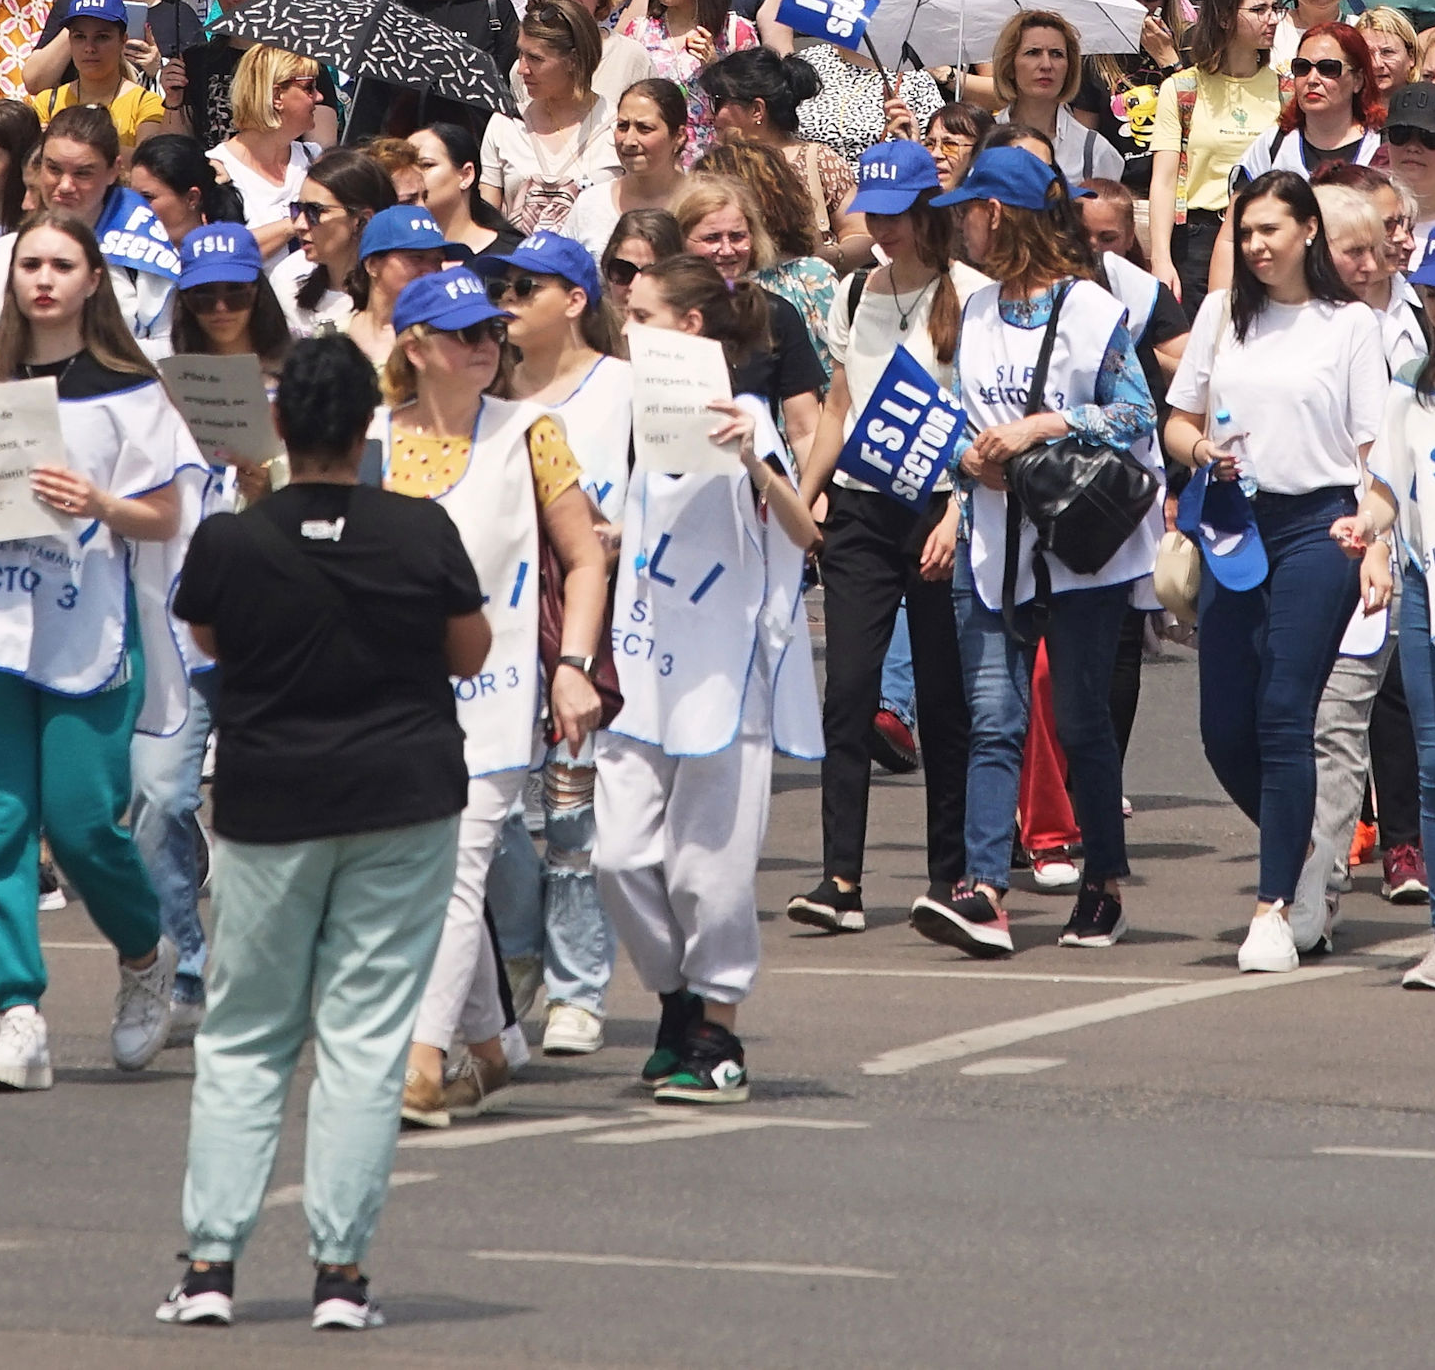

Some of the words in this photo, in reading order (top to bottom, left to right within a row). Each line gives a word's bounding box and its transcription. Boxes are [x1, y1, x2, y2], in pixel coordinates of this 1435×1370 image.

[862, 162, 898, 181] FSLI
[192, 234, 236, 259] FSLI
[445, 276, 485, 300] FSLI
[1054, 392, 1065, 411] 3
[859, 379, 932, 476] FSLI
[891, 410, 957, 503] SECTOR
[56, 583, 80, 611] 3
[504, 665, 521, 688] 3
[657, 652, 675, 678] 3
